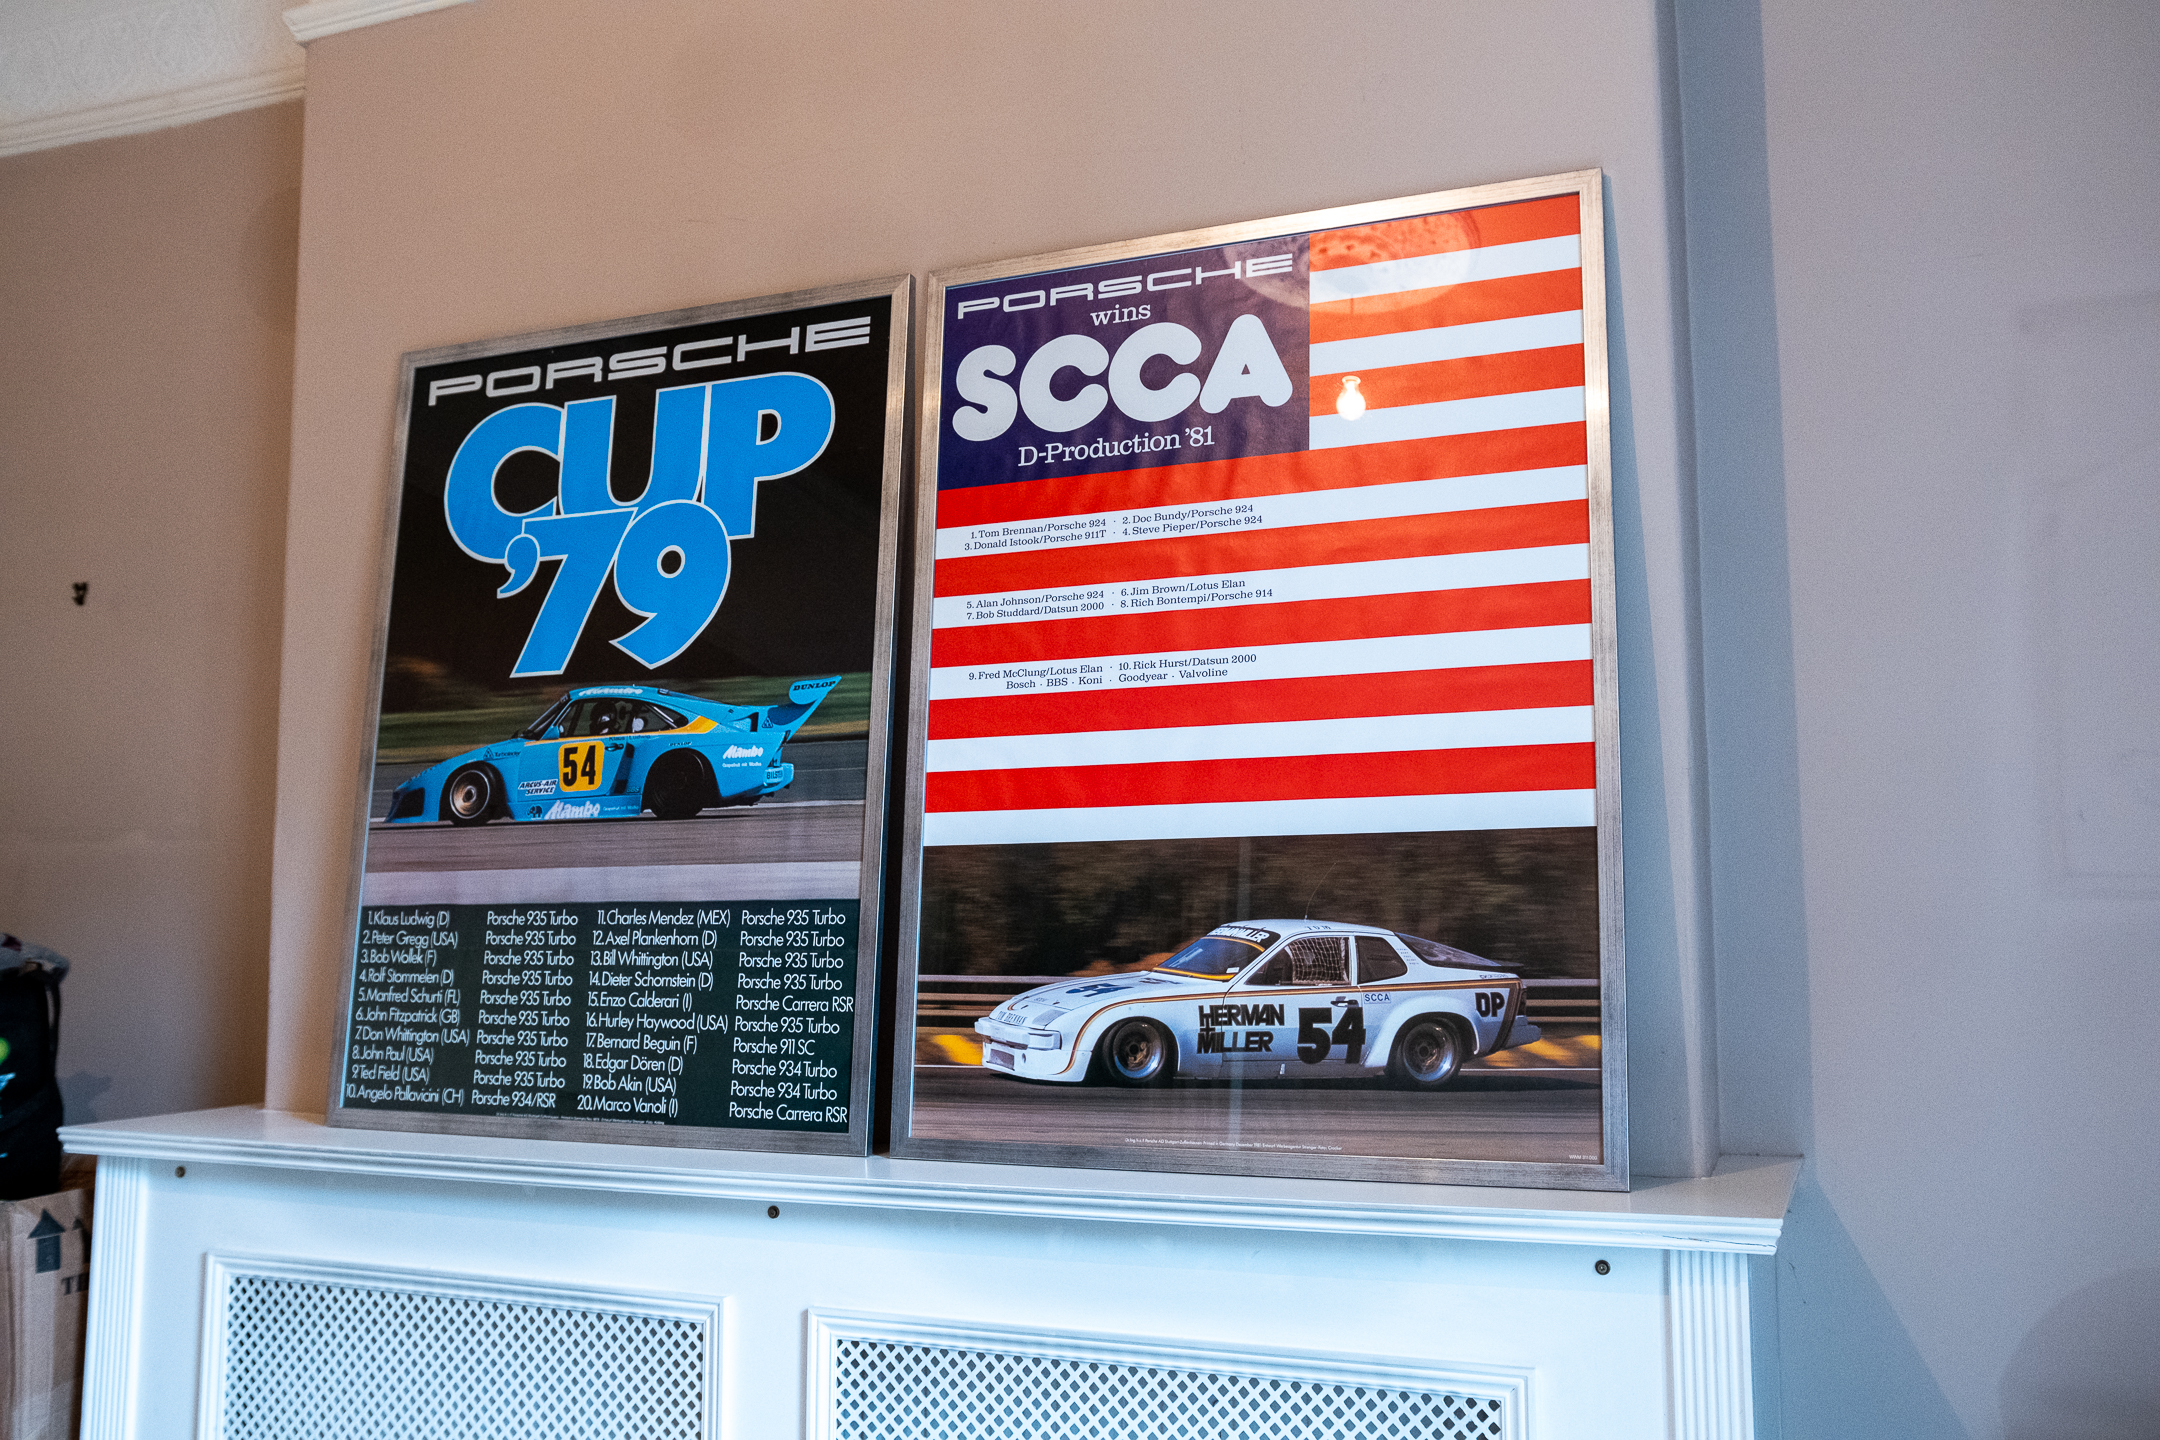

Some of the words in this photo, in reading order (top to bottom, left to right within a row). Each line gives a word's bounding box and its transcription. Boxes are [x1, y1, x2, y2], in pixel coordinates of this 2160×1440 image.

[958, 253, 1292, 319] PORSCHE
[1090, 304, 1151, 326] wins
[429, 316, 871, 406] PORSCHE
[952, 314, 1293, 441] SCCA
[1018, 429, 1181, 466] D-Production
[444, 371, 835, 564] CUP
[1132, 515, 1151, 523] Doc
[1154, 507, 1233, 522] Bundy/Porsche
[1235, 505, 1253, 514] 924
[978, 529, 999, 538] Tom
[1002, 521, 1086, 536] Brennan/Porsche
[1089, 519, 1106, 528] 924
[1132, 526, 1160, 535] Steve
[1163, 517, 1241, 533] Pieper/Porsche
[1244, 515, 1262, 524] 924
[974, 539, 1007, 550] Donald
[1010, 532, 1082, 546] Istook/Porsche
[1085, 530, 1106, 539] 911T
[1130, 587, 1149, 596] Jim
[1152, 582, 1219, 594] Brown/Lotus
[1221, 580, 1245, 589] Elan
[1131, 598, 1154, 607] Rich
[1157, 591, 1253, 605] Bontempi/Porsche
[1256, 589, 1272, 597] 914
[976, 600, 998, 608] Alan
[1000, 592, 1084, 606] Johnson/Porsche
[1087, 591, 1104, 599] 924
[976, 611, 994, 619] Bob
[997, 605, 1078, 618] Studdard/Datsun
[1080, 602, 1104, 611] 2000
[978, 671, 1000, 679] Fred
[1002, 666, 1077, 678] McClung/Lotus
[1080, 664, 1103, 673] Elan
[1133, 660, 1156, 670] Rick
[1159, 657, 1229, 668] Hurst/Datsun
[1231, 654, 1256, 663] 2000
[793, 681, 836, 691] DUNLOP
[1006, 680, 1035, 689] Bosch
[1046, 678, 1068, 687] BBS
[1078, 676, 1102, 685] Koni
[1119, 672, 1168, 683] Goodyear
[1179, 669, 1227, 678] Valvoline
[723, 745, 763, 759] Mambo
[563, 745, 596, 786] 54
[545, 800, 600, 819] Mambo
[400, 909, 434, 928] Ludwig
[437, 910, 449, 928] (D)
[487, 909, 525, 925] Porsche
[527, 911, 547, 925] 935
[549, 909, 578, 925] Turbo
[649, 908, 694, 925] Mendez
[697, 909, 730, 928] (MEX)
[396, 931, 428, 948] Gregg
[431, 931, 458, 949] (USA)
[632, 929, 698, 946] Plankenhorn
[702, 930, 717, 949] (D)
[391, 948, 422, 964] Wollek
[425, 949, 436, 967] (F)
[618, 949, 678, 969] Whittington
[682, 951, 713, 970] (USA)
[387, 968, 439, 983] Stommelen
[441, 969, 454, 986] (D)
[634, 970, 695, 987] Schornstein
[698, 972, 713, 991] (D)
[411, 987, 443, 1003] Schurti
[444, 989, 460, 1007] (FL)
[629, 991, 679, 1008] Calderari
[736, 993, 779, 1010] Porsche
[782, 995, 828, 1011] Carrera
[832, 996, 853, 1012] RSR
[1365, 993, 1390, 1002] SCCA
[1475, 992, 1505, 1017] DP
[389, 1007, 437, 1025] Fitzpatrick
[439, 1009, 459, 1026] (GB)
[636, 1013, 695, 1032] Haywood
[697, 1014, 728, 1034] (USA)
[1198, 1004, 1284, 1027] HERMAN
[385, 1026, 439, 1045] Whittington
[441, 1028, 469, 1047] (USA)
[643, 1034, 680, 1053] Beguin
[684, 1035, 697, 1054] (F)
[733, 1036, 777, 1053] Porsche
[780, 1039, 795, 1054] 911
[797, 1040, 815, 1055] SC
[1197, 1031, 1273, 1054] MILLER
[1297, 1007, 1366, 1064] 54
[385, 1045, 405, 1060] Paul
[406, 1047, 434, 1065] (USA)
[631, 1055, 665, 1071] Dören
[668, 1056, 683, 1075] (D)
[378, 1065, 400, 1080] Field
[402, 1066, 429, 1085] (USA)
[732, 1058, 776, 1075] Porsche
[779, 1060, 801, 1076] 934
[803, 1060, 837, 1078] Turbo
[618, 1074, 642, 1091] Akin
[645, 1076, 676, 1096] (USA)
[731, 1079, 775, 1097] Porsche
[778, 1082, 800, 1098] 934
[803, 1082, 837, 1100] Turbo
[394, 1085, 440, 1102] Pallavicini
[442, 1088, 464, 1107] (CH)
[472, 1089, 509, 1105] Porsche
[512, 1091, 556, 1108] 934/RSR
[633, 1097, 666, 1114] Vanoli
[729, 1101, 773, 1119] Porsche
[776, 1104, 822, 1122] Carrera
[826, 1106, 847, 1123] RSR
